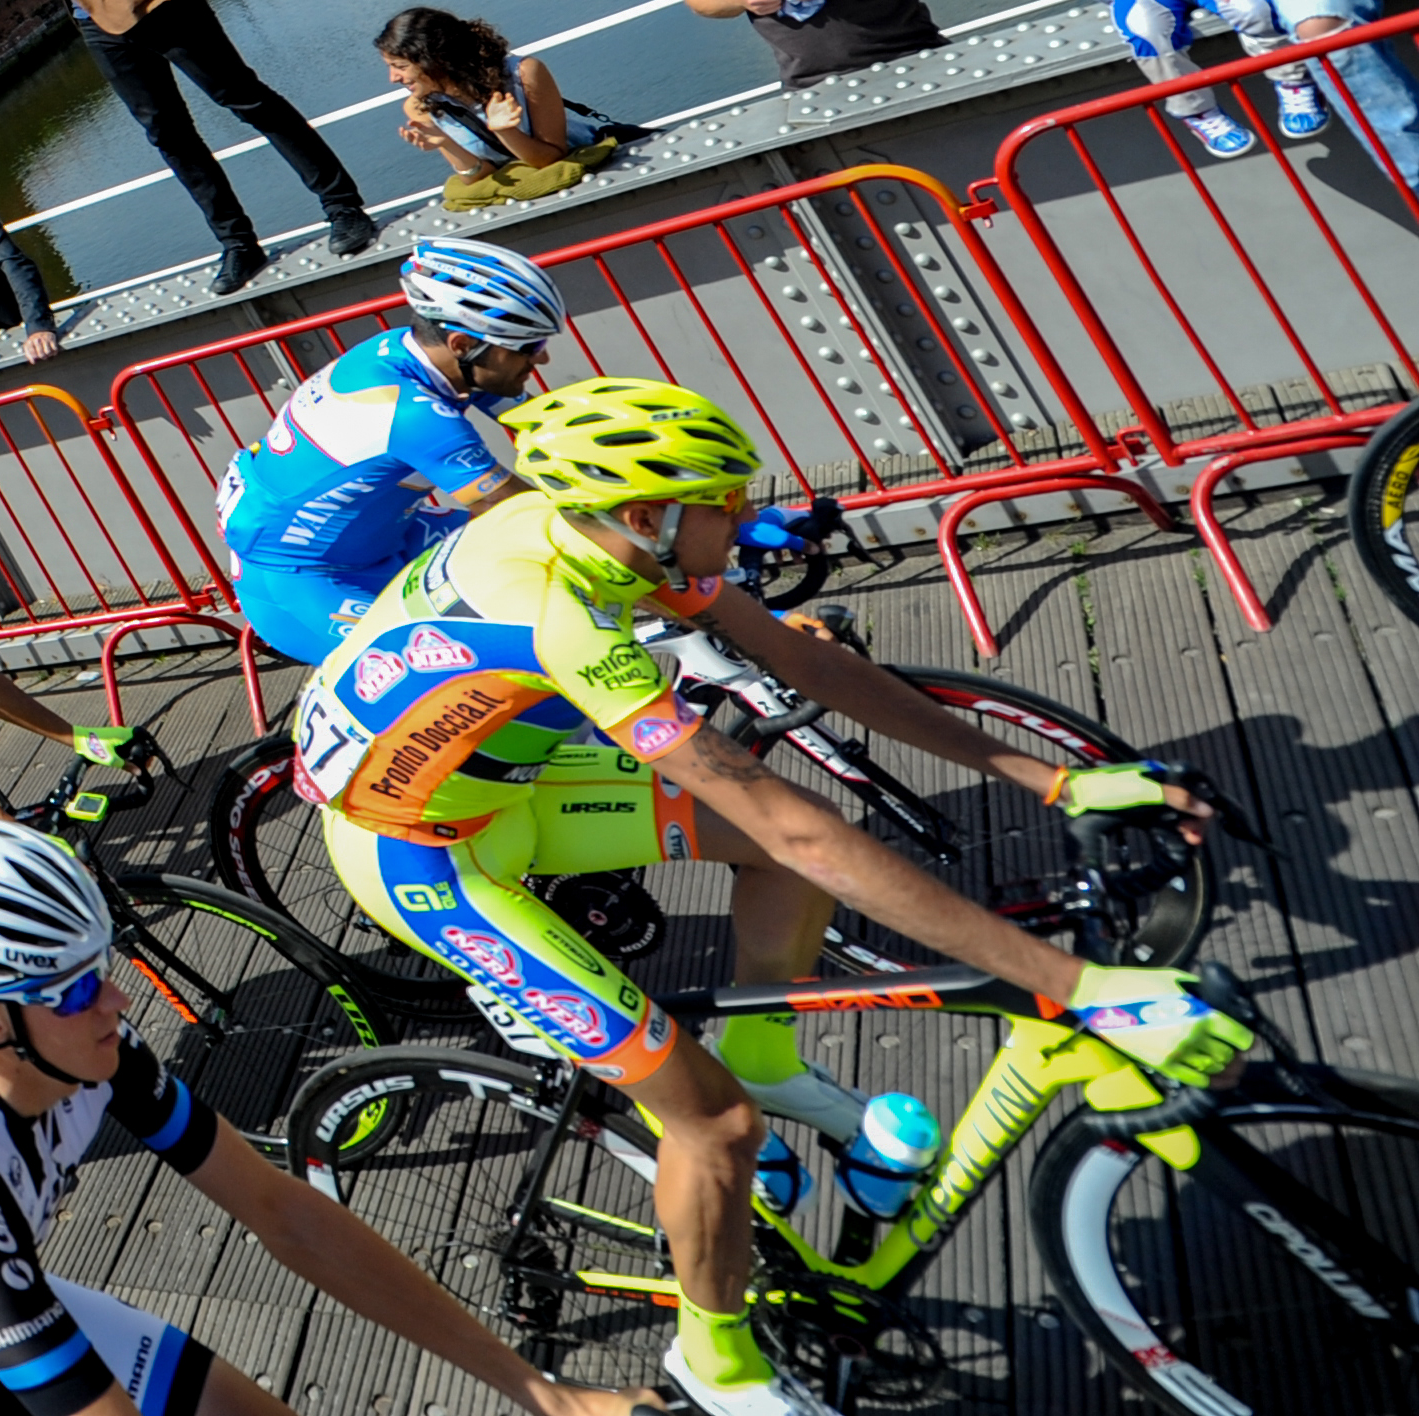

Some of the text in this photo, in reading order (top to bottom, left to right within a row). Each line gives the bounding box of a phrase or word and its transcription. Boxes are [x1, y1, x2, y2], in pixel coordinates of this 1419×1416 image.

[280, 477, 375, 545] WANTY
[1386, 470, 1409, 509] AERO
[408, 646, 468, 667] NERI
[577, 647, 643, 687] Yellow
[369, 689, 507, 800] Pronto Doccia.it
[560, 801, 637, 814] URSUS
[4, 947, 59, 970] uvex
[449, 931, 515, 982] NERI
[528, 994, 599, 1041] NERI
[314, 1074, 416, 1143] URSUS
[909, 1063, 1044, 1252] CIPOLLINI
[126, 1335, 153, 1401] MANO
